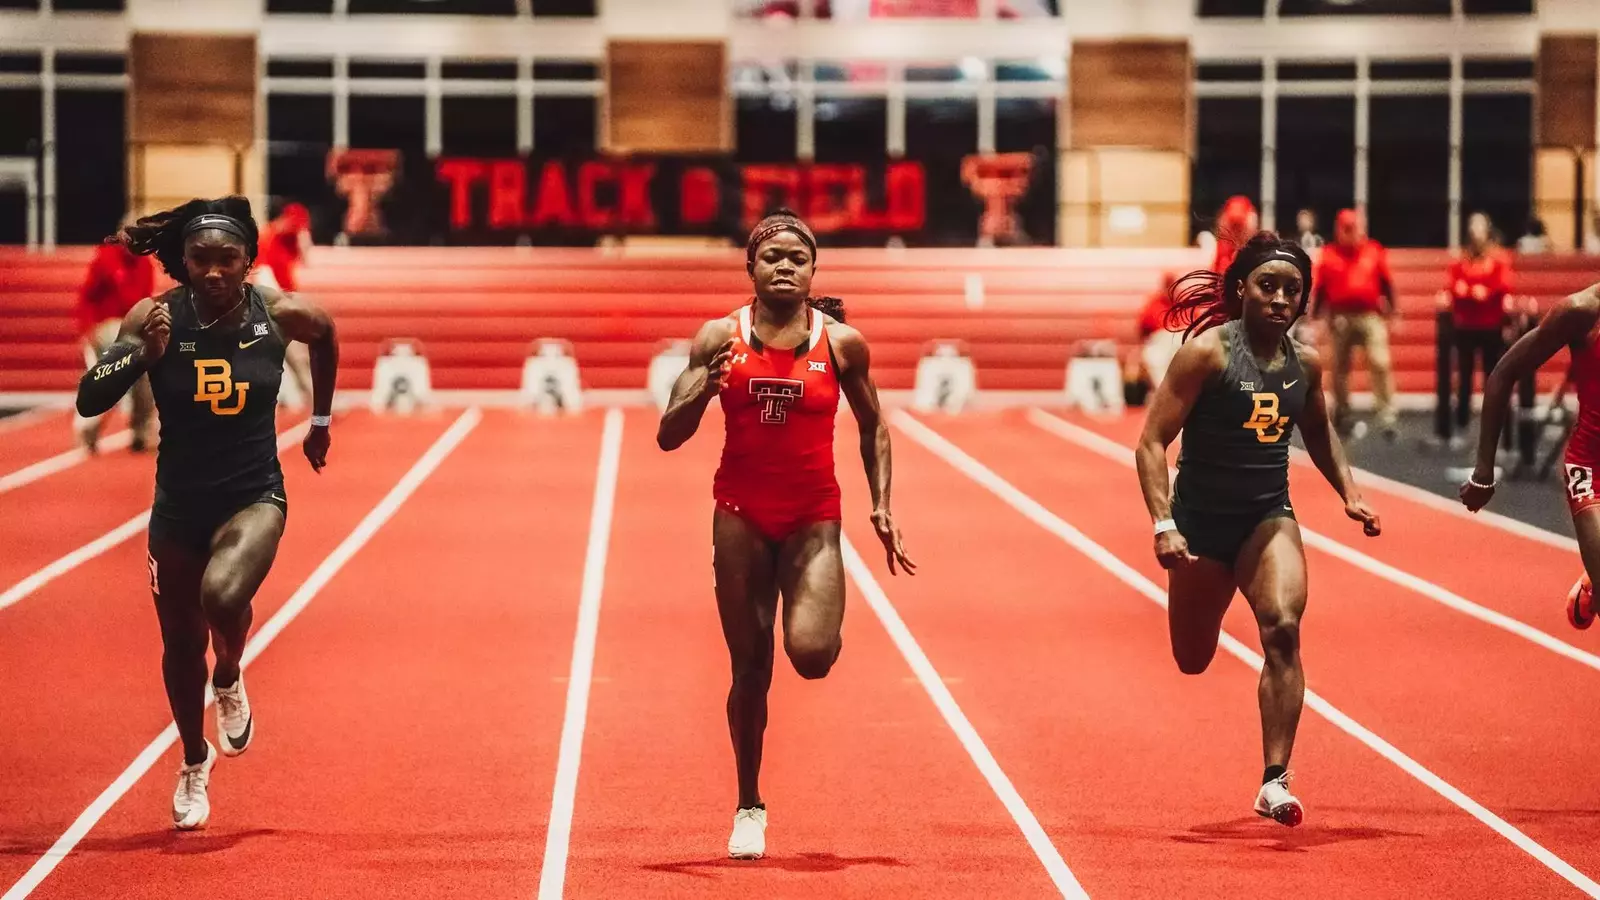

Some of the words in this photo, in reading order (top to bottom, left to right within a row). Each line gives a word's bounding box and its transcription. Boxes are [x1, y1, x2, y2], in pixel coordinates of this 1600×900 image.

[437, 160, 654, 228] TRACK
[253, 323, 269, 335] ONE
[194, 359, 249, 415] BU
[1570, 467, 1587, 496] 2
